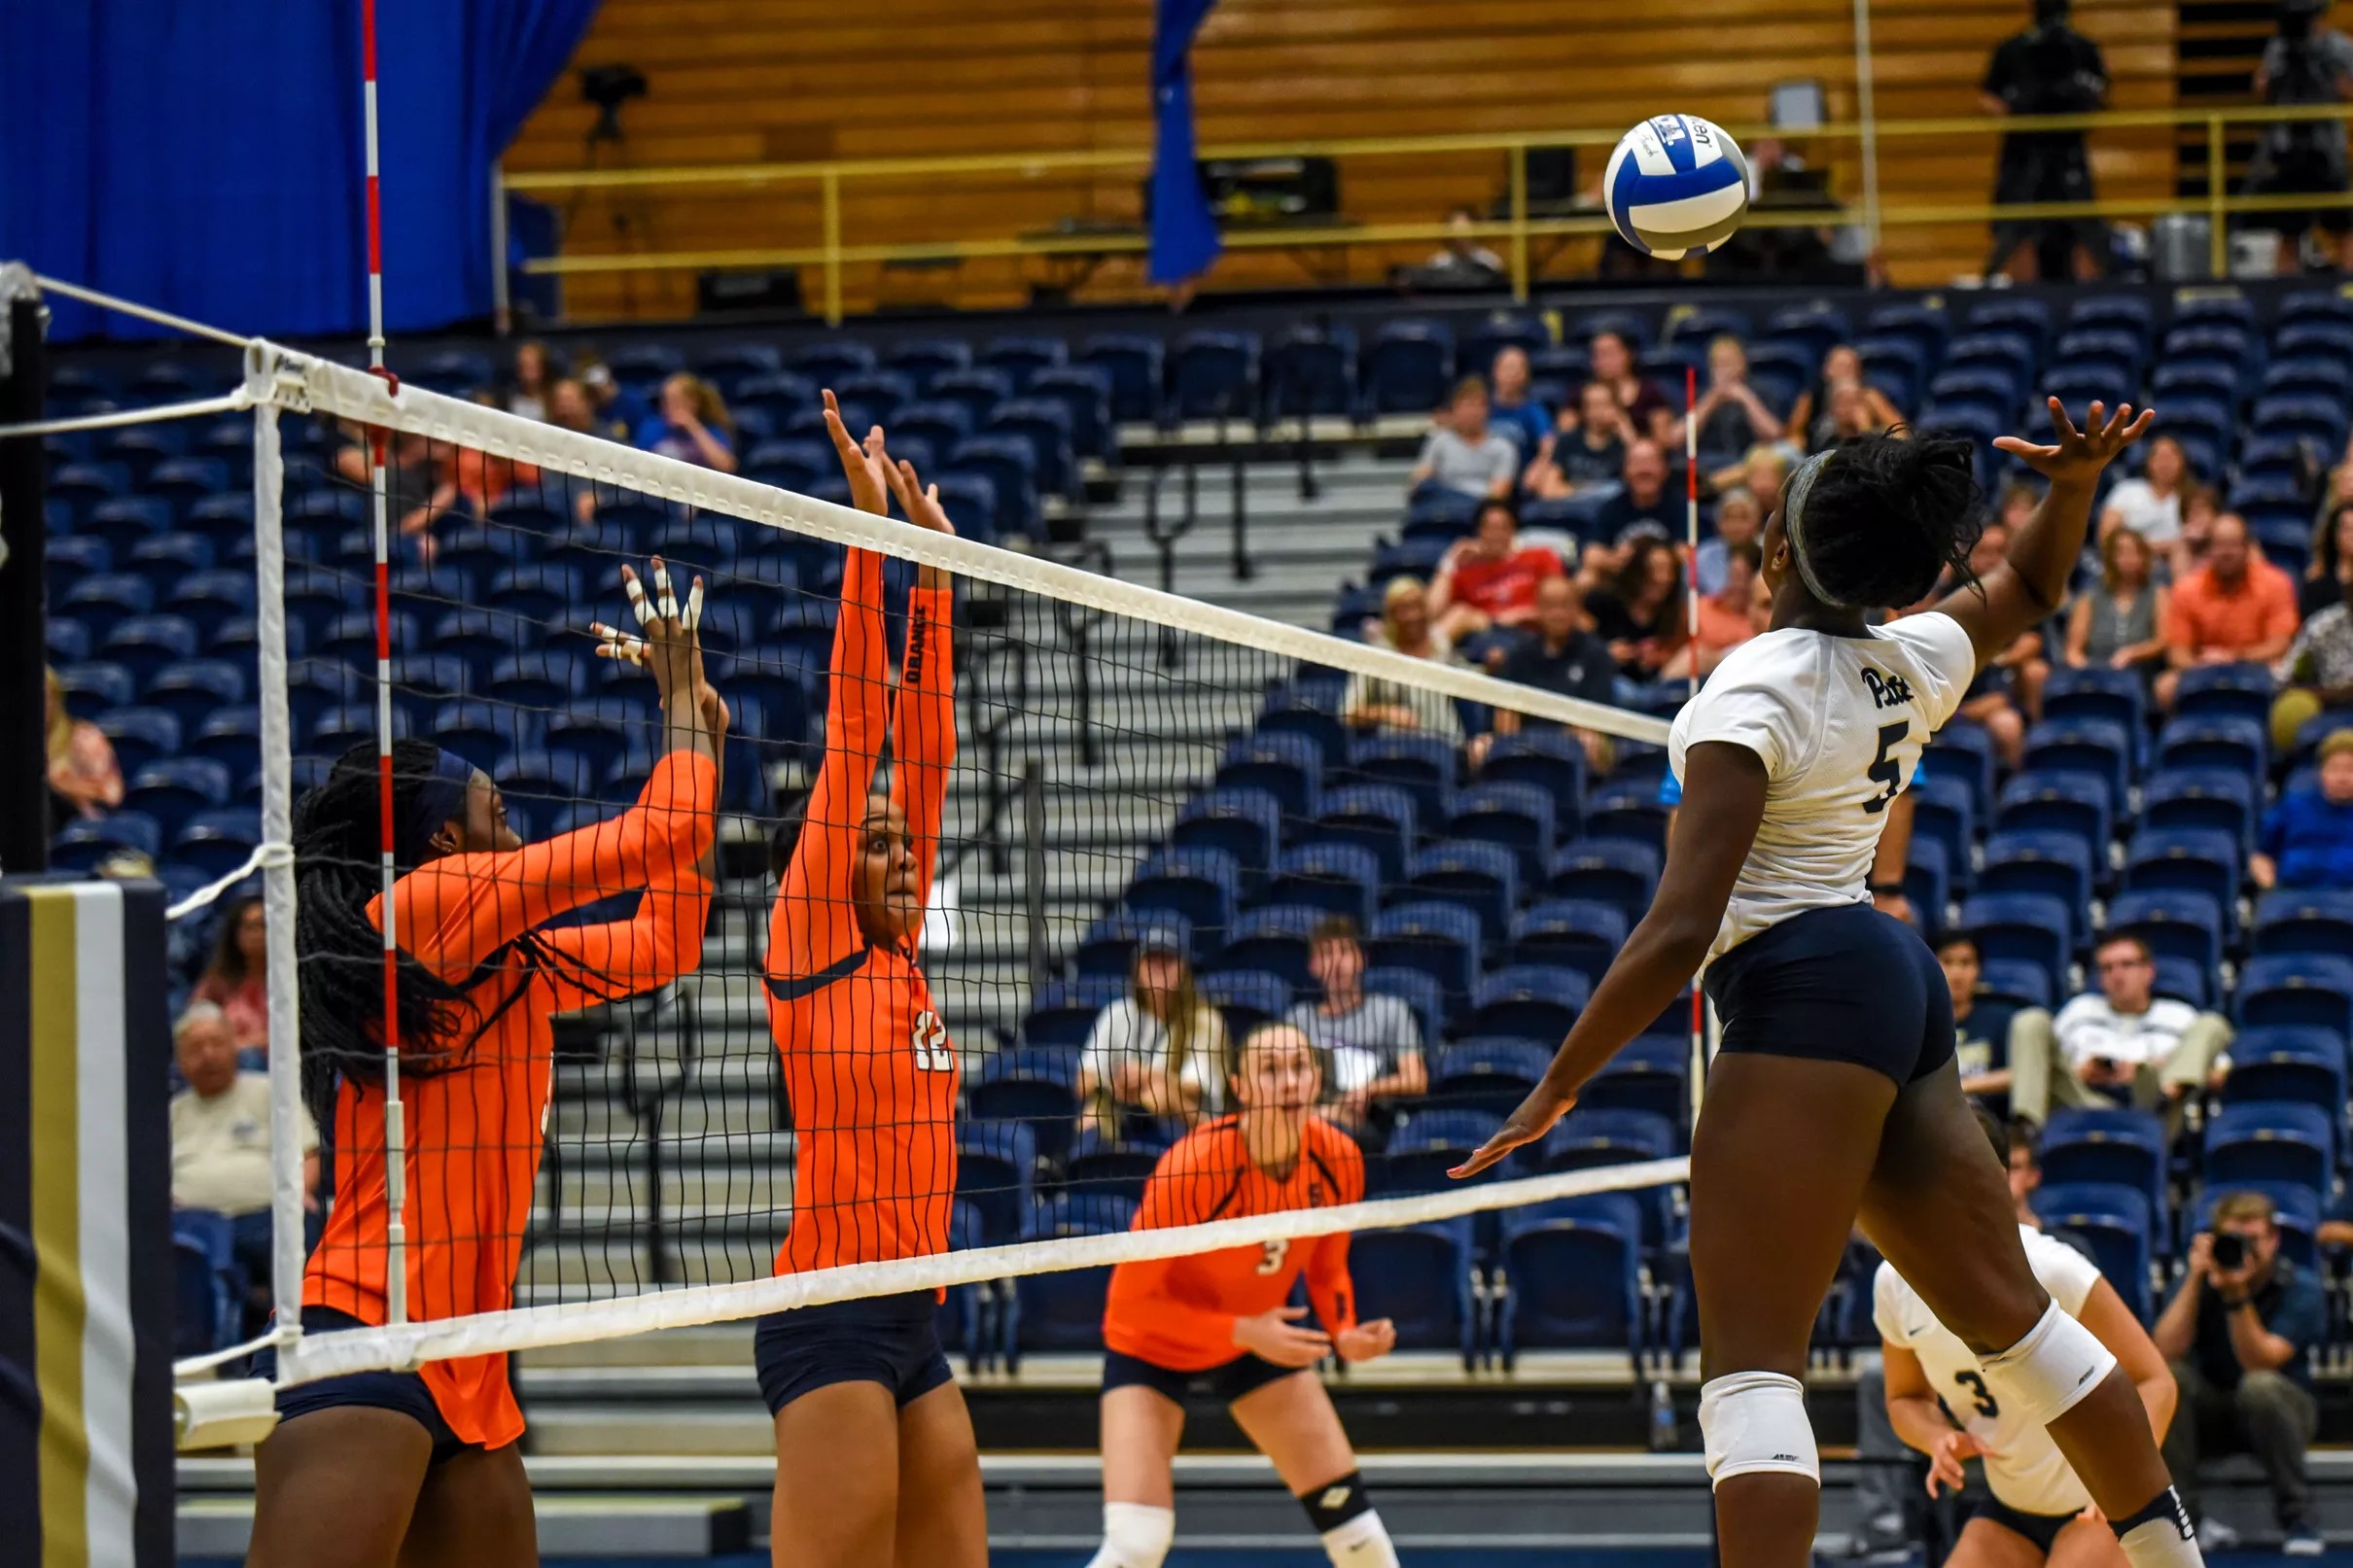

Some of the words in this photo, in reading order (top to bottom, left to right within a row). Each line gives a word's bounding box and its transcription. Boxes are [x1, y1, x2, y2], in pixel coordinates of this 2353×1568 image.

[1862, 719, 1910, 814] 5
[913, 1010, 955, 1072] 12
[1255, 1237, 1291, 1275] 3
[1954, 1371, 1999, 1419] 3
